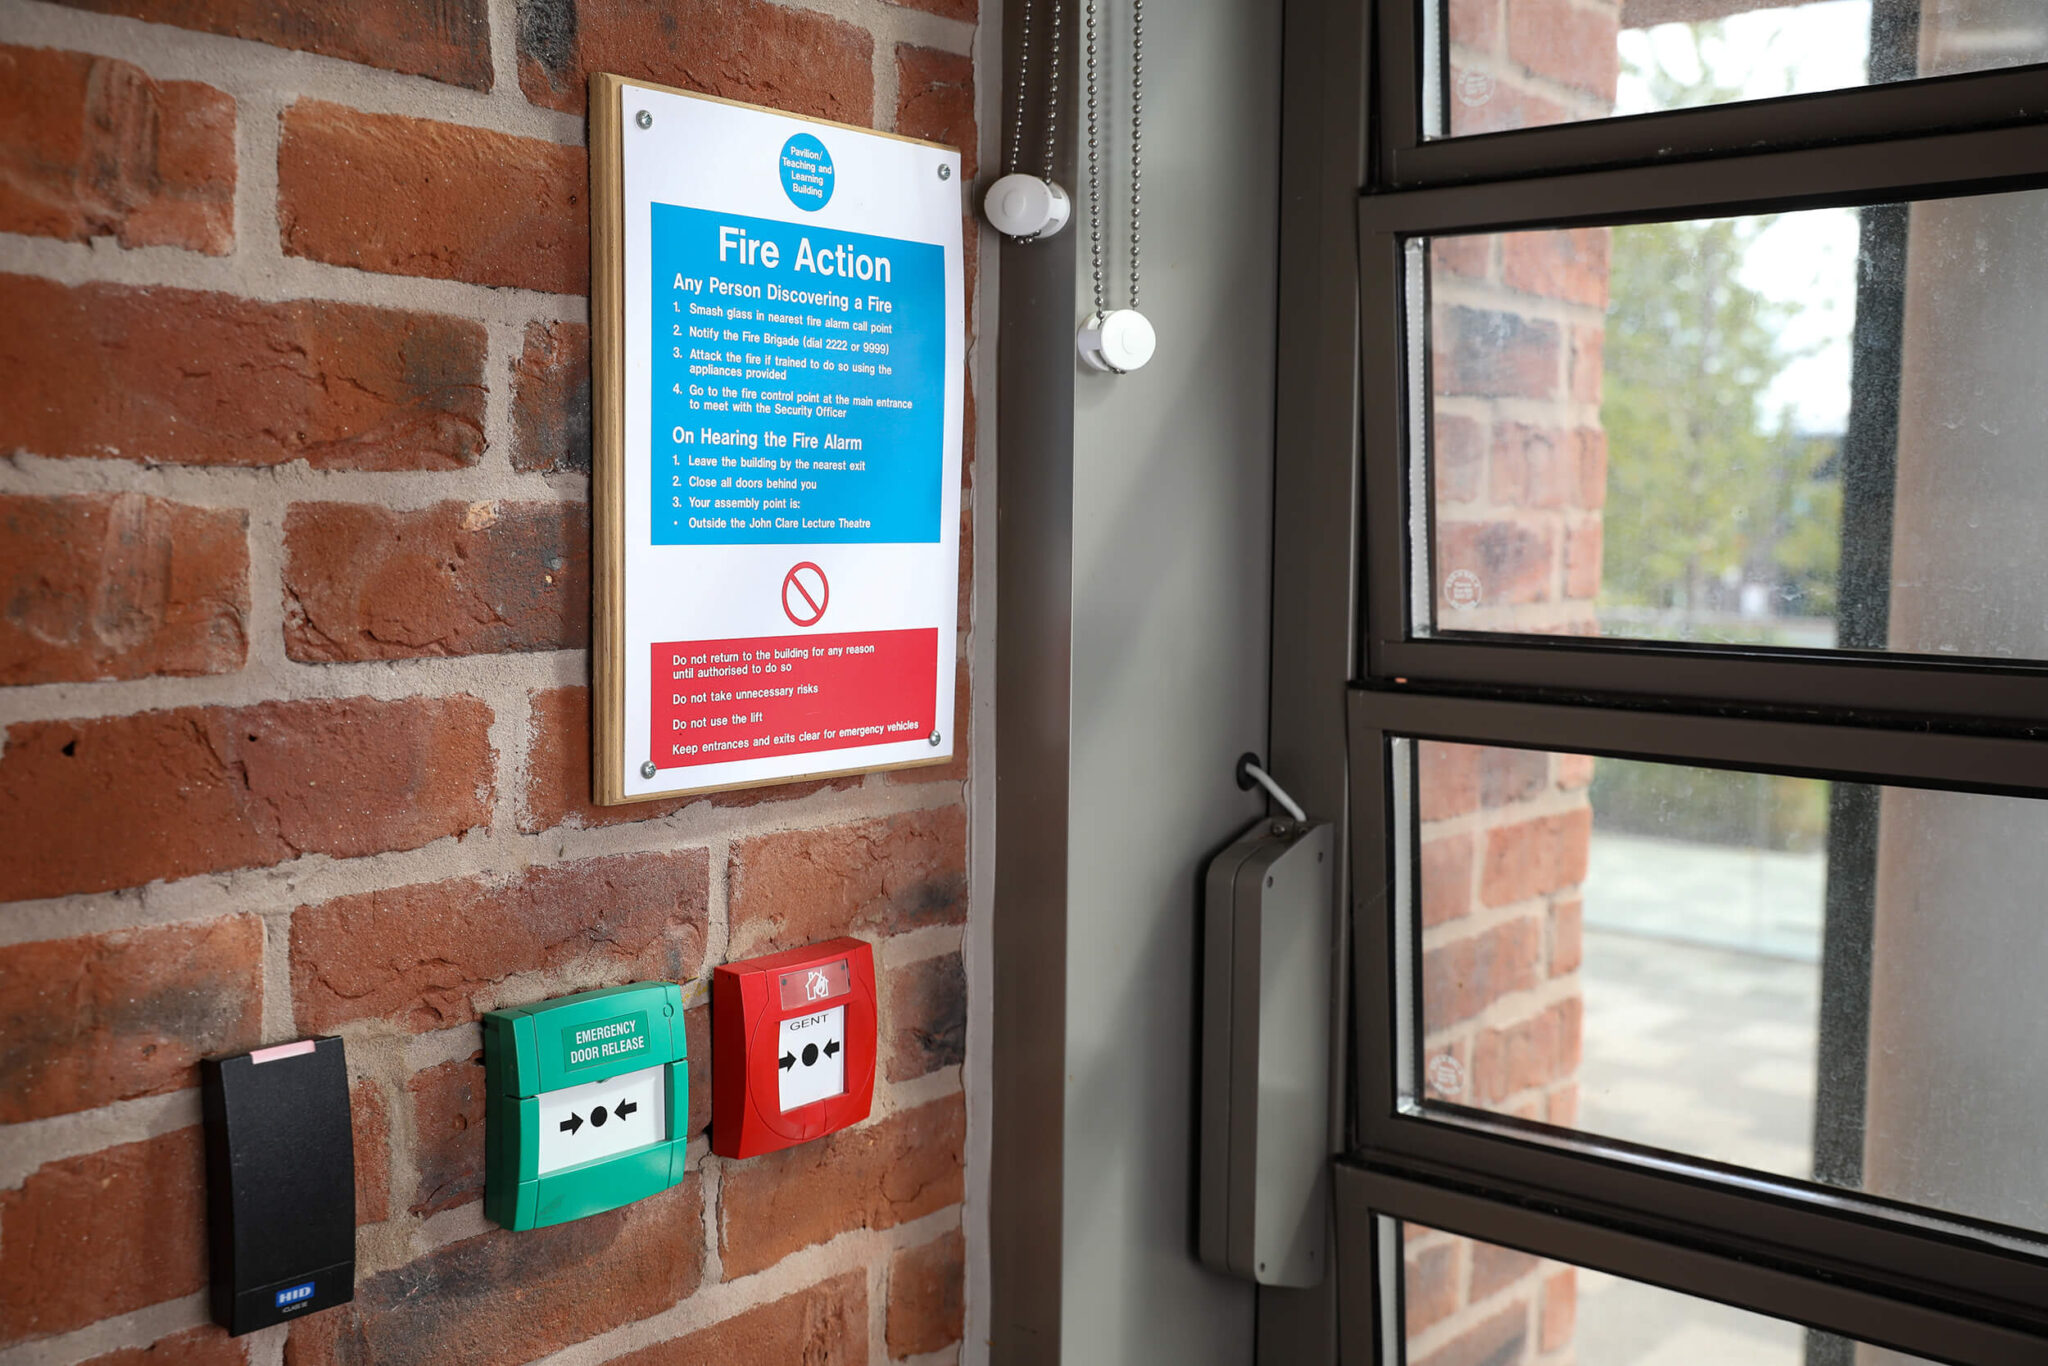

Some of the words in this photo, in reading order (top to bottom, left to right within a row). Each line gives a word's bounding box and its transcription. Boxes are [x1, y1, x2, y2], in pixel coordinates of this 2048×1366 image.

[790, 146, 823, 161] Pavilion/
[782, 156, 816, 173] Teaching
[818, 165, 833, 174] and
[791, 170, 824, 186] Learning
[793, 182, 823, 199] Building
[719, 225, 780, 269] Fire
[793, 237, 891, 283] Action
[672, 272, 703, 295] Any
[709, 276, 761, 299] Person
[767, 283, 849, 312] Discovering
[853, 297, 862, 310] a
[867, 295, 892, 313] Fire
[672, 301, 680, 313] 1.
[689, 302, 723, 317] Smash
[726, 307, 753, 320] glass
[756, 309, 765, 321] in
[767, 313, 803, 325] nearest
[806, 315, 822, 327] fire
[824, 317, 850, 329] alarm
[851, 320, 868, 331] call
[870, 322, 892, 334] point
[672, 324, 682, 336] 2.
[689, 325, 719, 341] Notify
[722, 329, 739, 341] the
[742, 330, 761, 343] Fire
[763, 332, 799, 347] Brigade
[802, 335, 823, 349] (dial
[825, 338, 848, 351] 2222
[850, 343, 860, 352] or
[862, 341, 889, 355] 9999)
[672, 346, 683, 358] 3.
[689, 348, 722, 361] Attack
[725, 351, 742, 363] the
[745, 352, 762, 365] fire
[764, 354, 772, 365] if
[774, 355, 807, 368] trained
[809, 358, 820, 370] to
[822, 359, 835, 371] do
[837, 362, 849, 372] so
[851, 362, 875, 376] using
[878, 364, 892, 375] the
[688, 363, 743, 377] appliances
[745, 367, 787, 380] provided
[672, 383, 683, 394] 4.
[688, 383, 704, 396] Go
[707, 385, 718, 397] to
[721, 386, 738, 398] the
[741, 387, 757, 399] fire
[760, 390, 794, 401] control
[796, 391, 820, 404] point
[822, 393, 832, 404] at
[835, 394, 850, 405] the
[852, 395, 873, 406] main
[875, 397, 913, 409] entrance
[689, 398, 700, 410] to
[703, 400, 729, 411] meet
[732, 401, 752, 413] with
[755, 401, 771, 414] the
[774, 403, 813, 418] Security
[815, 405, 847, 418] Officer
[672, 425, 694, 444] On
[700, 427, 758, 450] Hearing
[763, 430, 787, 448] the
[792, 431, 819, 449] Fire
[823, 433, 862, 451] Alarm
[672, 453, 680, 466] 1.
[688, 454, 718, 467] Leave
[720, 455, 737, 467] the
[740, 456, 777, 471] building
[779, 457, 792, 471] by
[794, 458, 810, 470] the
[812, 460, 846, 470] nearest
[849, 460, 866, 471] exit
[672, 475, 682, 487] 2.
[688, 475, 717, 488] Close
[720, 476, 732, 488] all
[734, 476, 764, 489] doors
[766, 477, 797, 489] behind
[800, 480, 817, 491] you
[671, 495, 682, 508] 3.
[688, 495, 711, 508] Your
[714, 497, 760, 511] assembly
[762, 497, 787, 511] point
[789, 497, 800, 509] is:
[688, 516, 727, 529] Outside
[730, 517, 746, 529] the
[748, 517, 772, 528] John
[774, 517, 799, 529] Clare
[801, 517, 835, 528] Lecture
[837, 517, 871, 528] Theatre
[672, 654, 687, 666] Do
[690, 653, 707, 664] not
[710, 652, 739, 663] return
[742, 651, 752, 661] to
[755, 649, 771, 660] the
[774, 647, 809, 660] building
[811, 646, 825, 657] for
[827, 647, 843, 657] any
[845, 644, 875, 654] reason
[672, 667, 694, 679] until
[697, 663, 748, 678] authorised
[751, 663, 762, 674] to
[764, 662, 777, 673] do
[780, 663, 792, 672] so
[672, 693, 687, 705] Do
[690, 692, 707, 703] not
[710, 690, 732, 702] take
[735, 687, 794, 700] unnecessary
[796, 683, 819, 694] risks
[672, 718, 687, 730] Do
[690, 717, 707, 728] not
[710, 716, 728, 727] use
[731, 713, 747, 724] the
[750, 711, 763, 723] lift
[672, 743, 698, 756] Keep
[701, 739, 749, 752] entrances
[752, 734, 770, 747] and
[773, 733, 795, 745] exits
[798, 730, 821, 742] clear
[823, 728, 836, 739] for
[838, 725, 884, 737] emergency
[886, 720, 919, 732] vehicles
[789, 1013, 829, 1031] GENT
[576, 1020, 636, 1045] EMERGENCY
[570, 1046, 600, 1064] DOOR
[601, 1035, 645, 1057] RELEASE
[279, 1286, 312, 1303] HID
